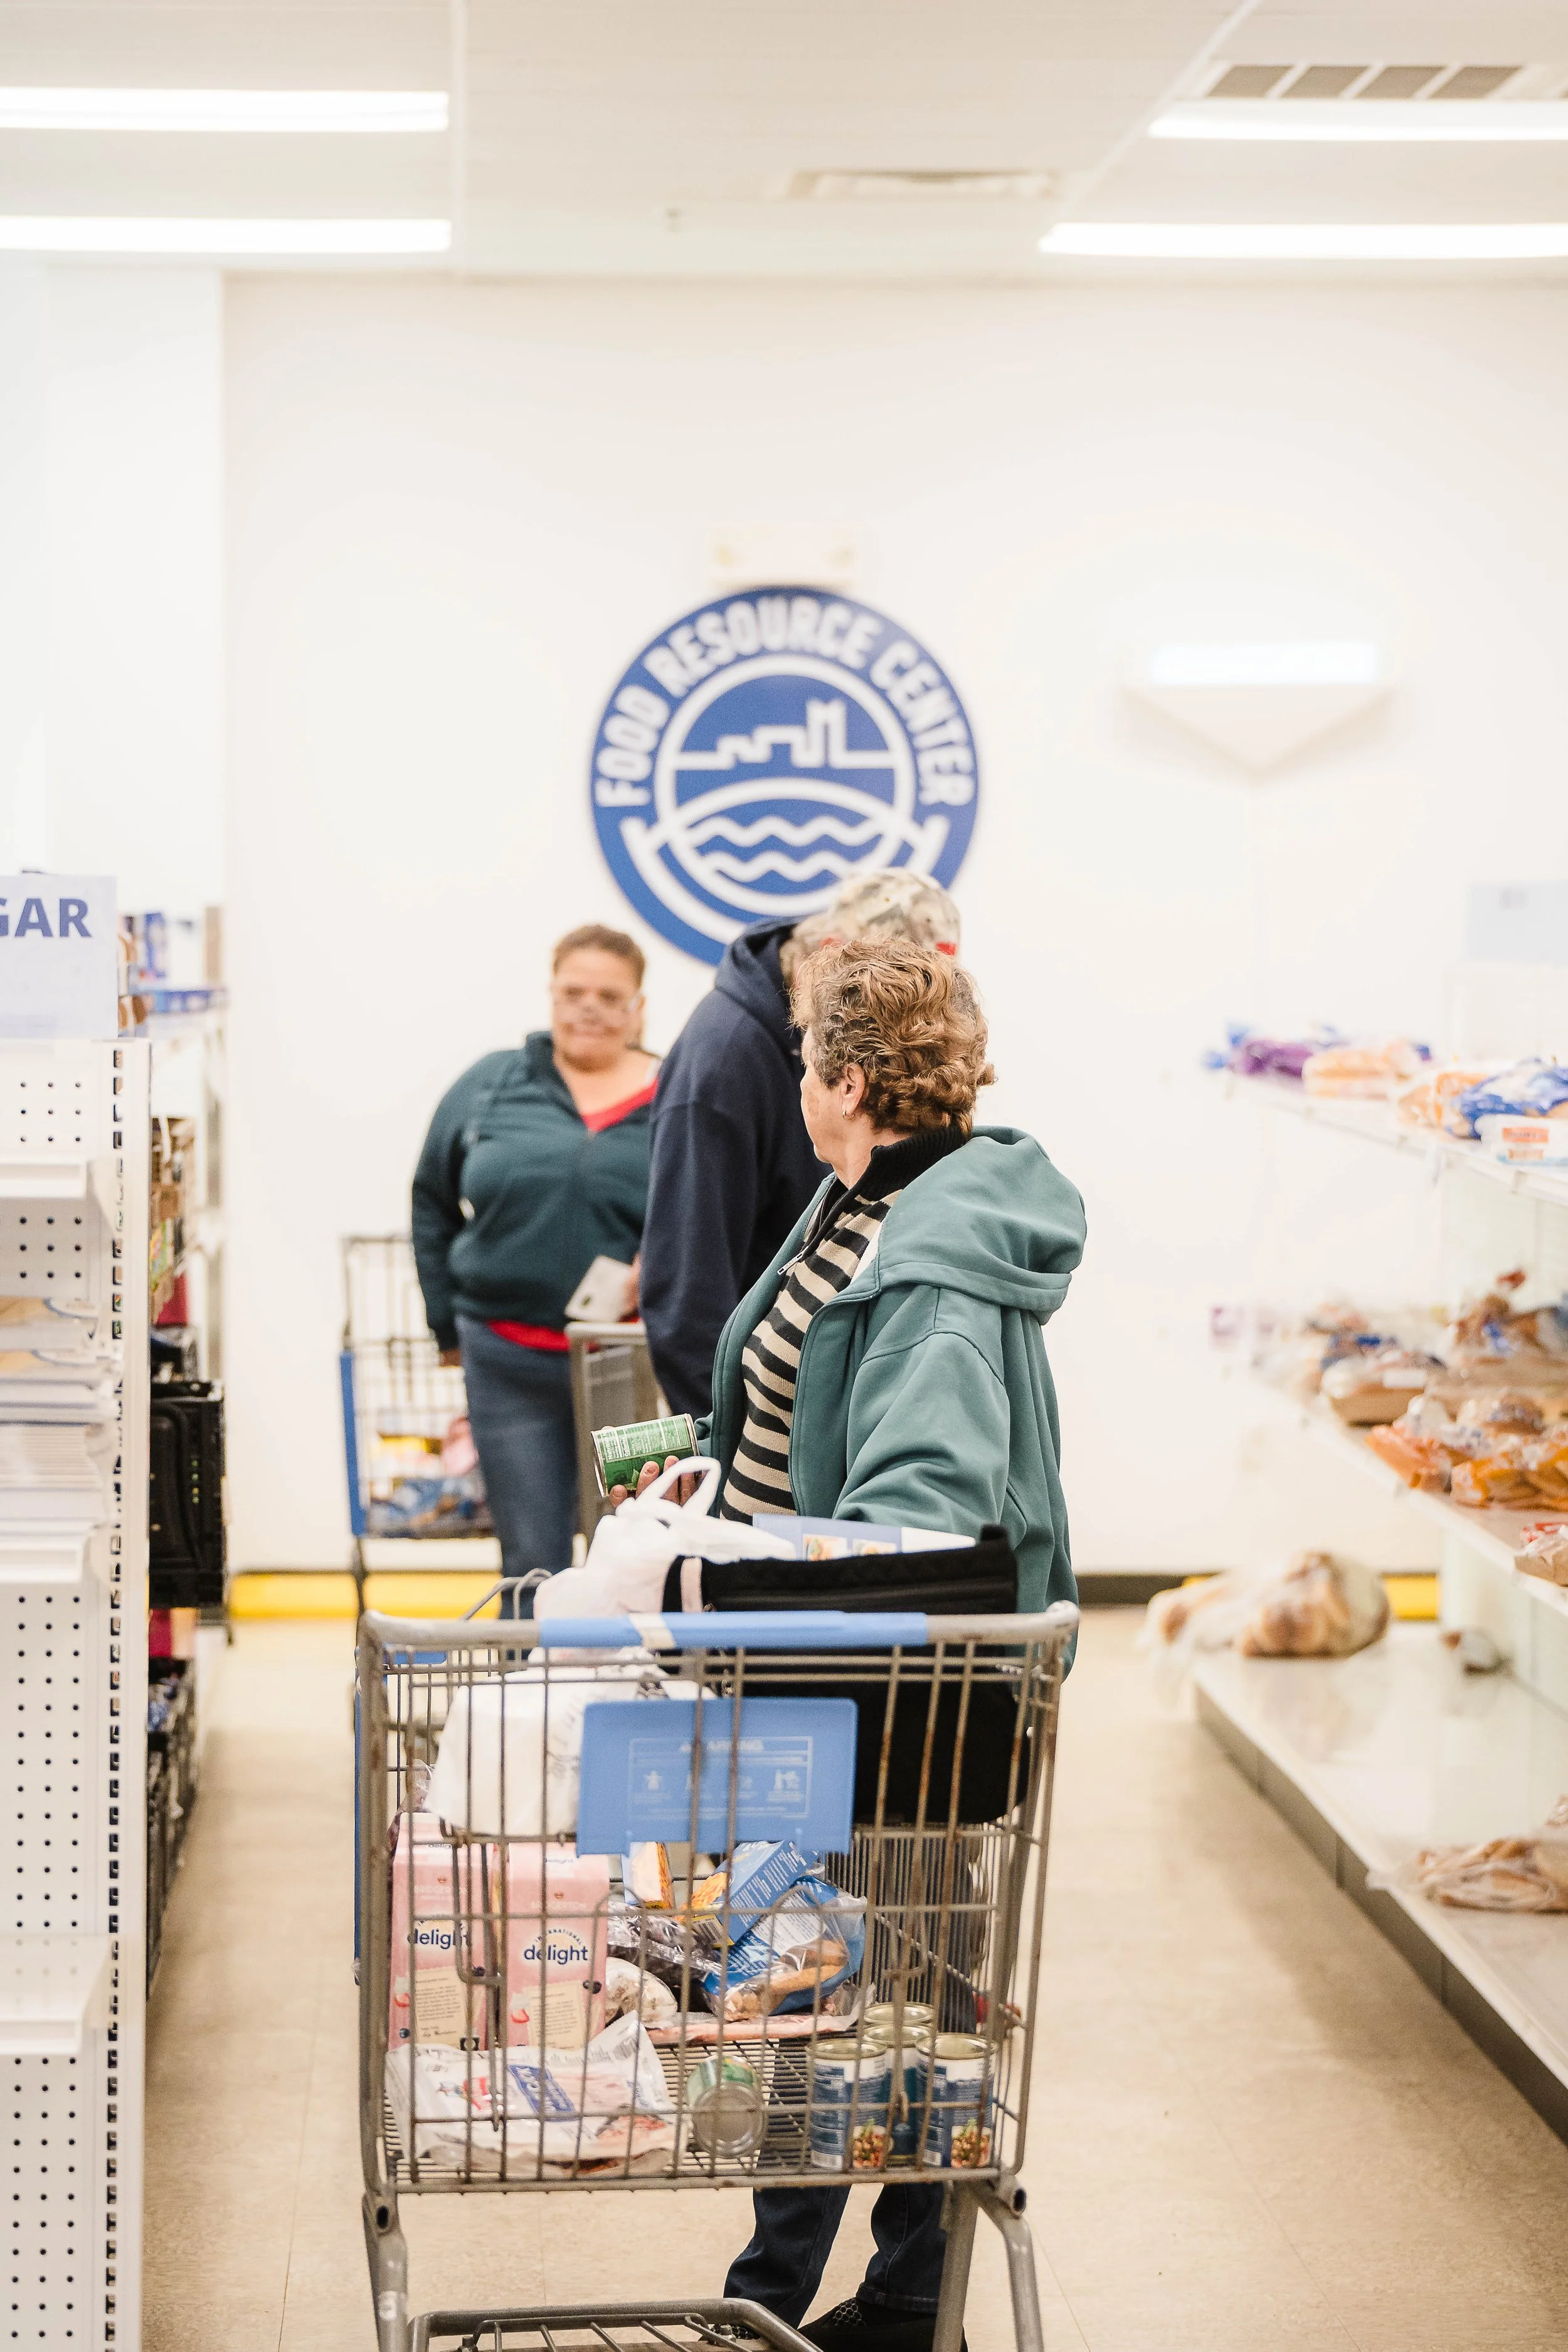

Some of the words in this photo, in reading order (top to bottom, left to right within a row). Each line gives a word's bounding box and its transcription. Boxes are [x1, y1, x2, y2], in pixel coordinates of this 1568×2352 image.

[595, 684, 671, 808] FOOD
[645, 595, 882, 696] RESOURCE
[871, 640, 973, 806] CENTER
[0, 898, 92, 938] AR
